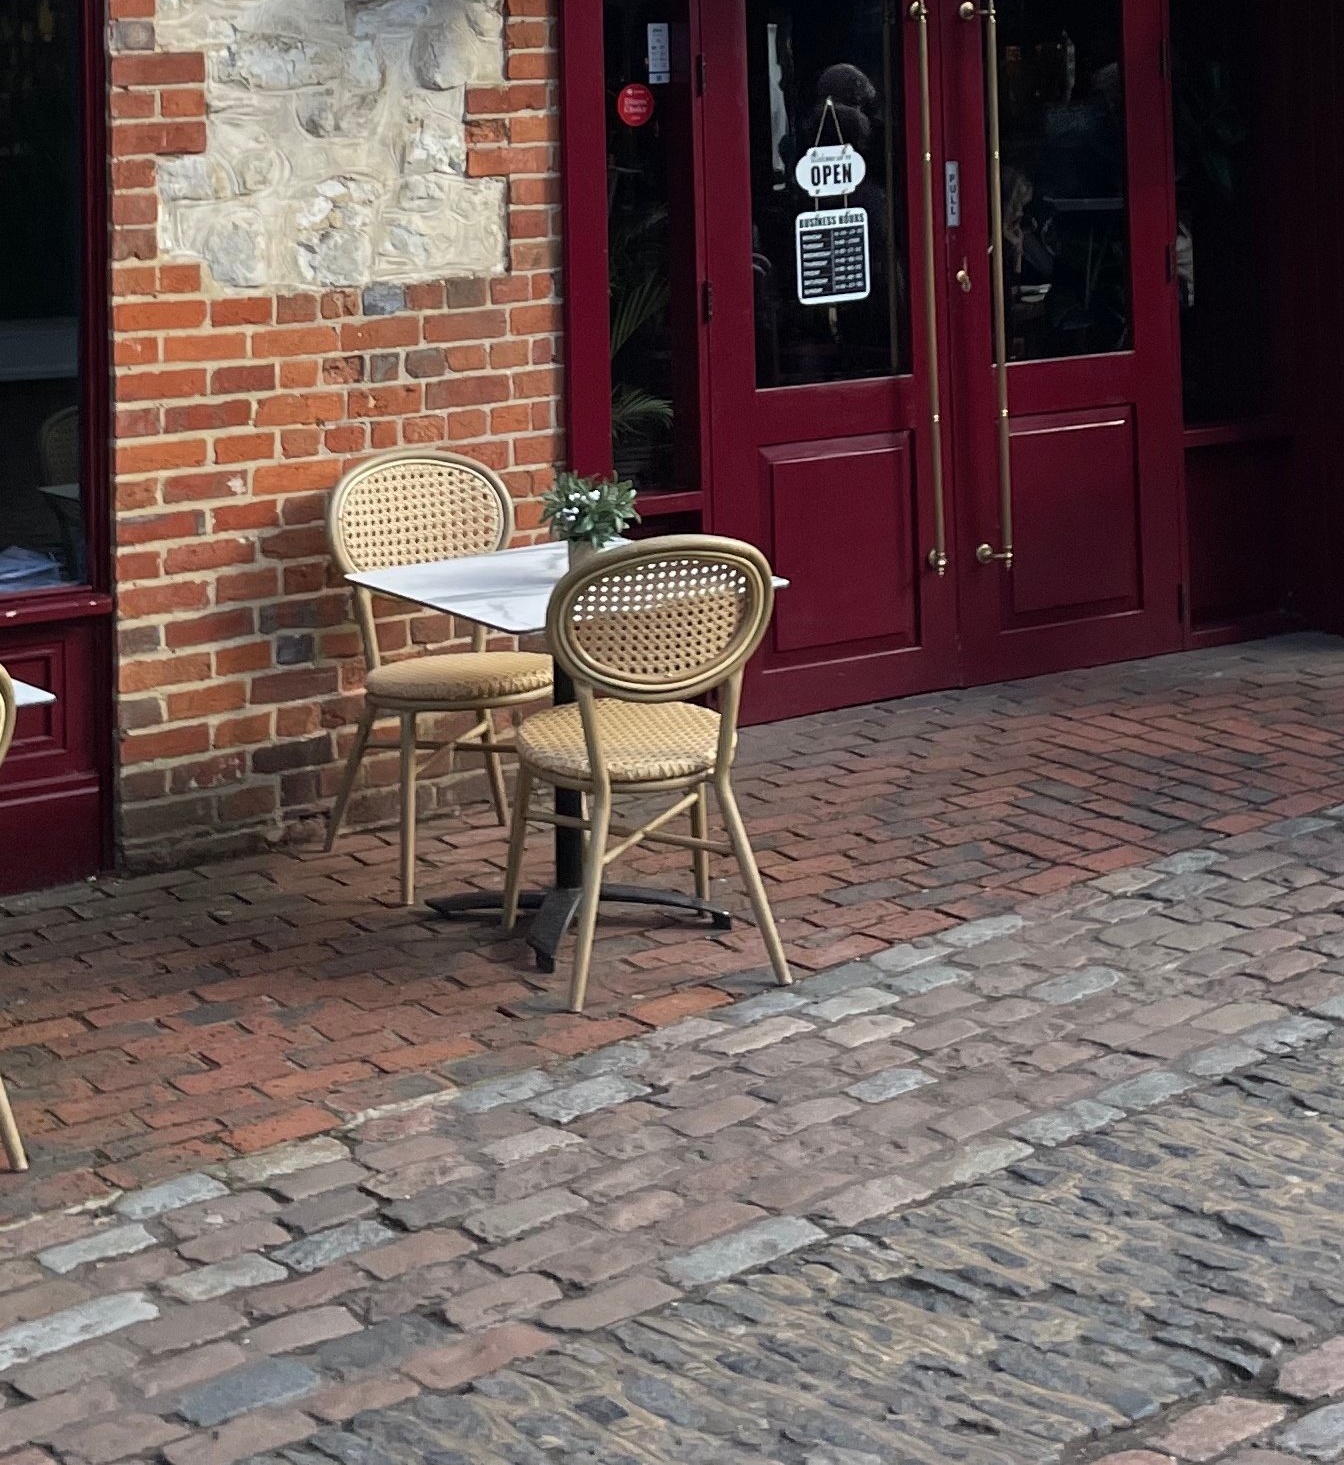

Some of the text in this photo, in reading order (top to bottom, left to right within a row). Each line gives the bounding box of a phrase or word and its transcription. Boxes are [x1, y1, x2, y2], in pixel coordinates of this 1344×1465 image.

[810, 163, 853, 187] OPEN
[948, 173, 958, 216] PULL
[799, 212, 865, 229] BUSINESS HOURS
